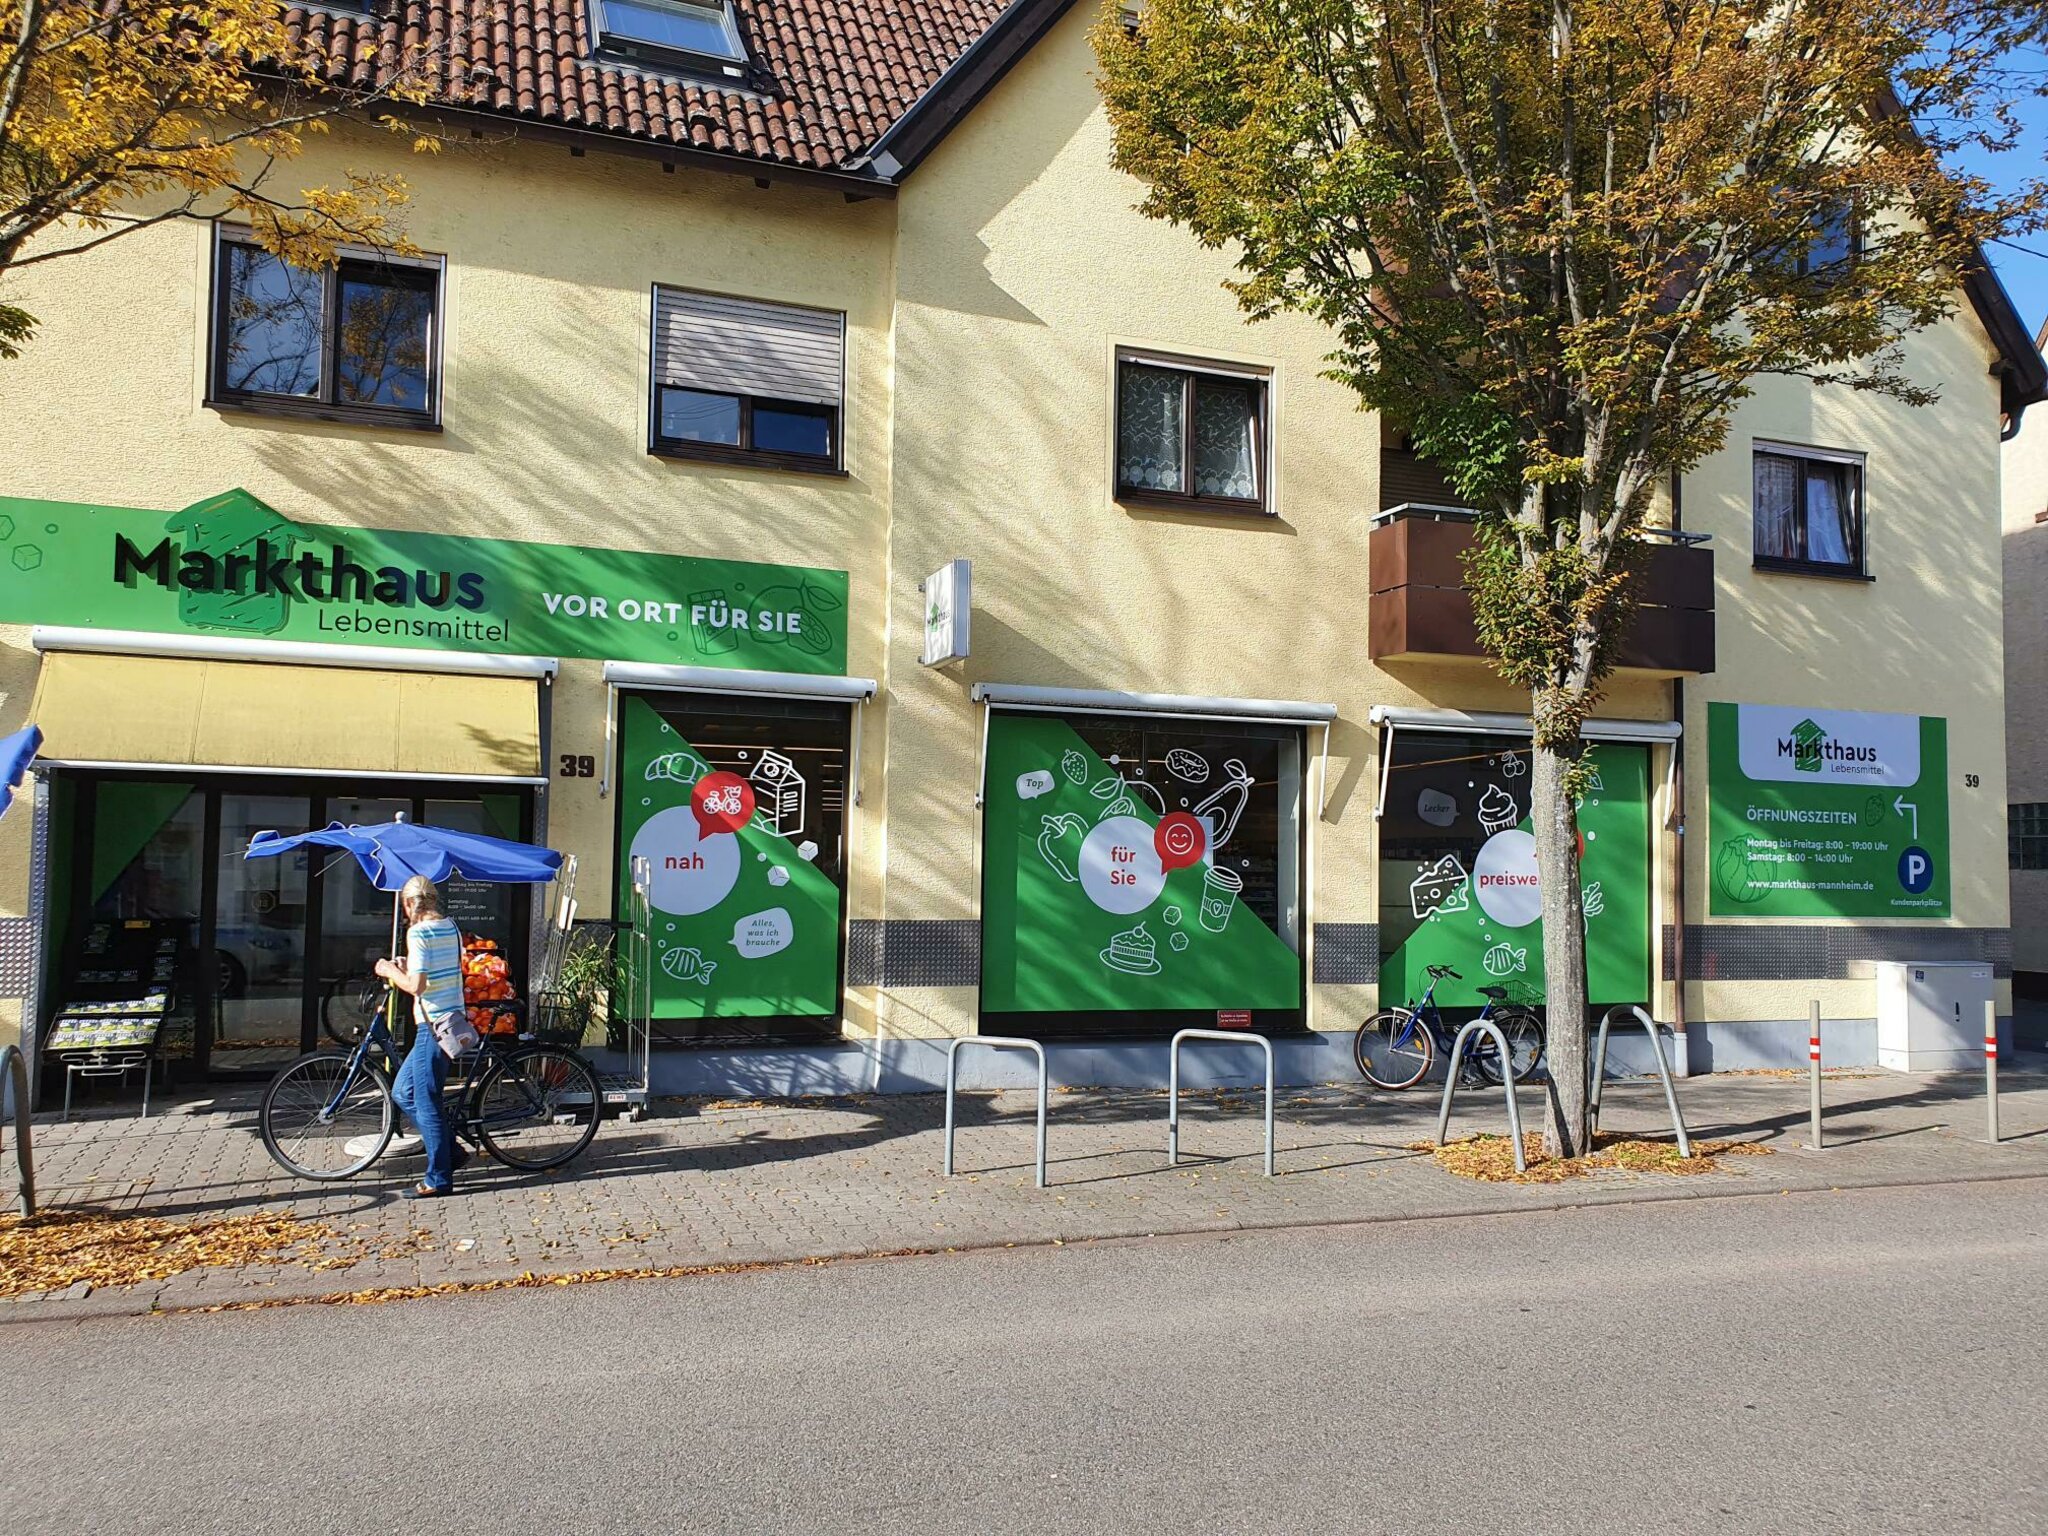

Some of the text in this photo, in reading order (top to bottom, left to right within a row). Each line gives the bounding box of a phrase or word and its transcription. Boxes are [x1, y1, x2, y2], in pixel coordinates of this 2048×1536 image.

[113, 532, 485, 609] Markthaus
[541, 592, 802, 634] VOR ORT FÜR SIE
[318, 608, 510, 642] Lebensmittel
[1778, 738, 1877, 763] Markthaus
[560, 754, 595, 778] 39
[1831, 763, 1885, 775] Lebensmittel
[1026, 778, 1044, 790] Top
[1965, 774, 1980, 788] 39
[1424, 803, 1450, 813] Lecker
[1746, 805, 1857, 825] ÖFFNUNGSZEITEN
[1747, 838, 1778, 849] Montag
[1780, 839, 1792, 848] bis
[1793, 840, 1824, 851] Freitag:
[1825, 841, 1843, 849] 8:00
[1851, 841, 1872, 850] 19:00
[1874, 842, 1889, 851] Uhr
[665, 852, 704, 870] nah
[1111, 846, 1136, 862] für
[1747, 852, 1785, 863] Samstag:
[1786, 853, 1805, 862] 8:00
[1815, 854, 1837, 863] 14:00
[1838, 854, 1853, 863] Uhr
[1110, 869, 1136, 885] Sie
[1908, 855, 1926, 885] P
[1480, 870, 1541, 888] preiswe
[1747, 880, 1874, 891] www.markthaus-mannheim.de
[751, 919, 775, 927] Alles,
[747, 929, 779, 937] was ich
[746, 938, 780, 946] brauche
